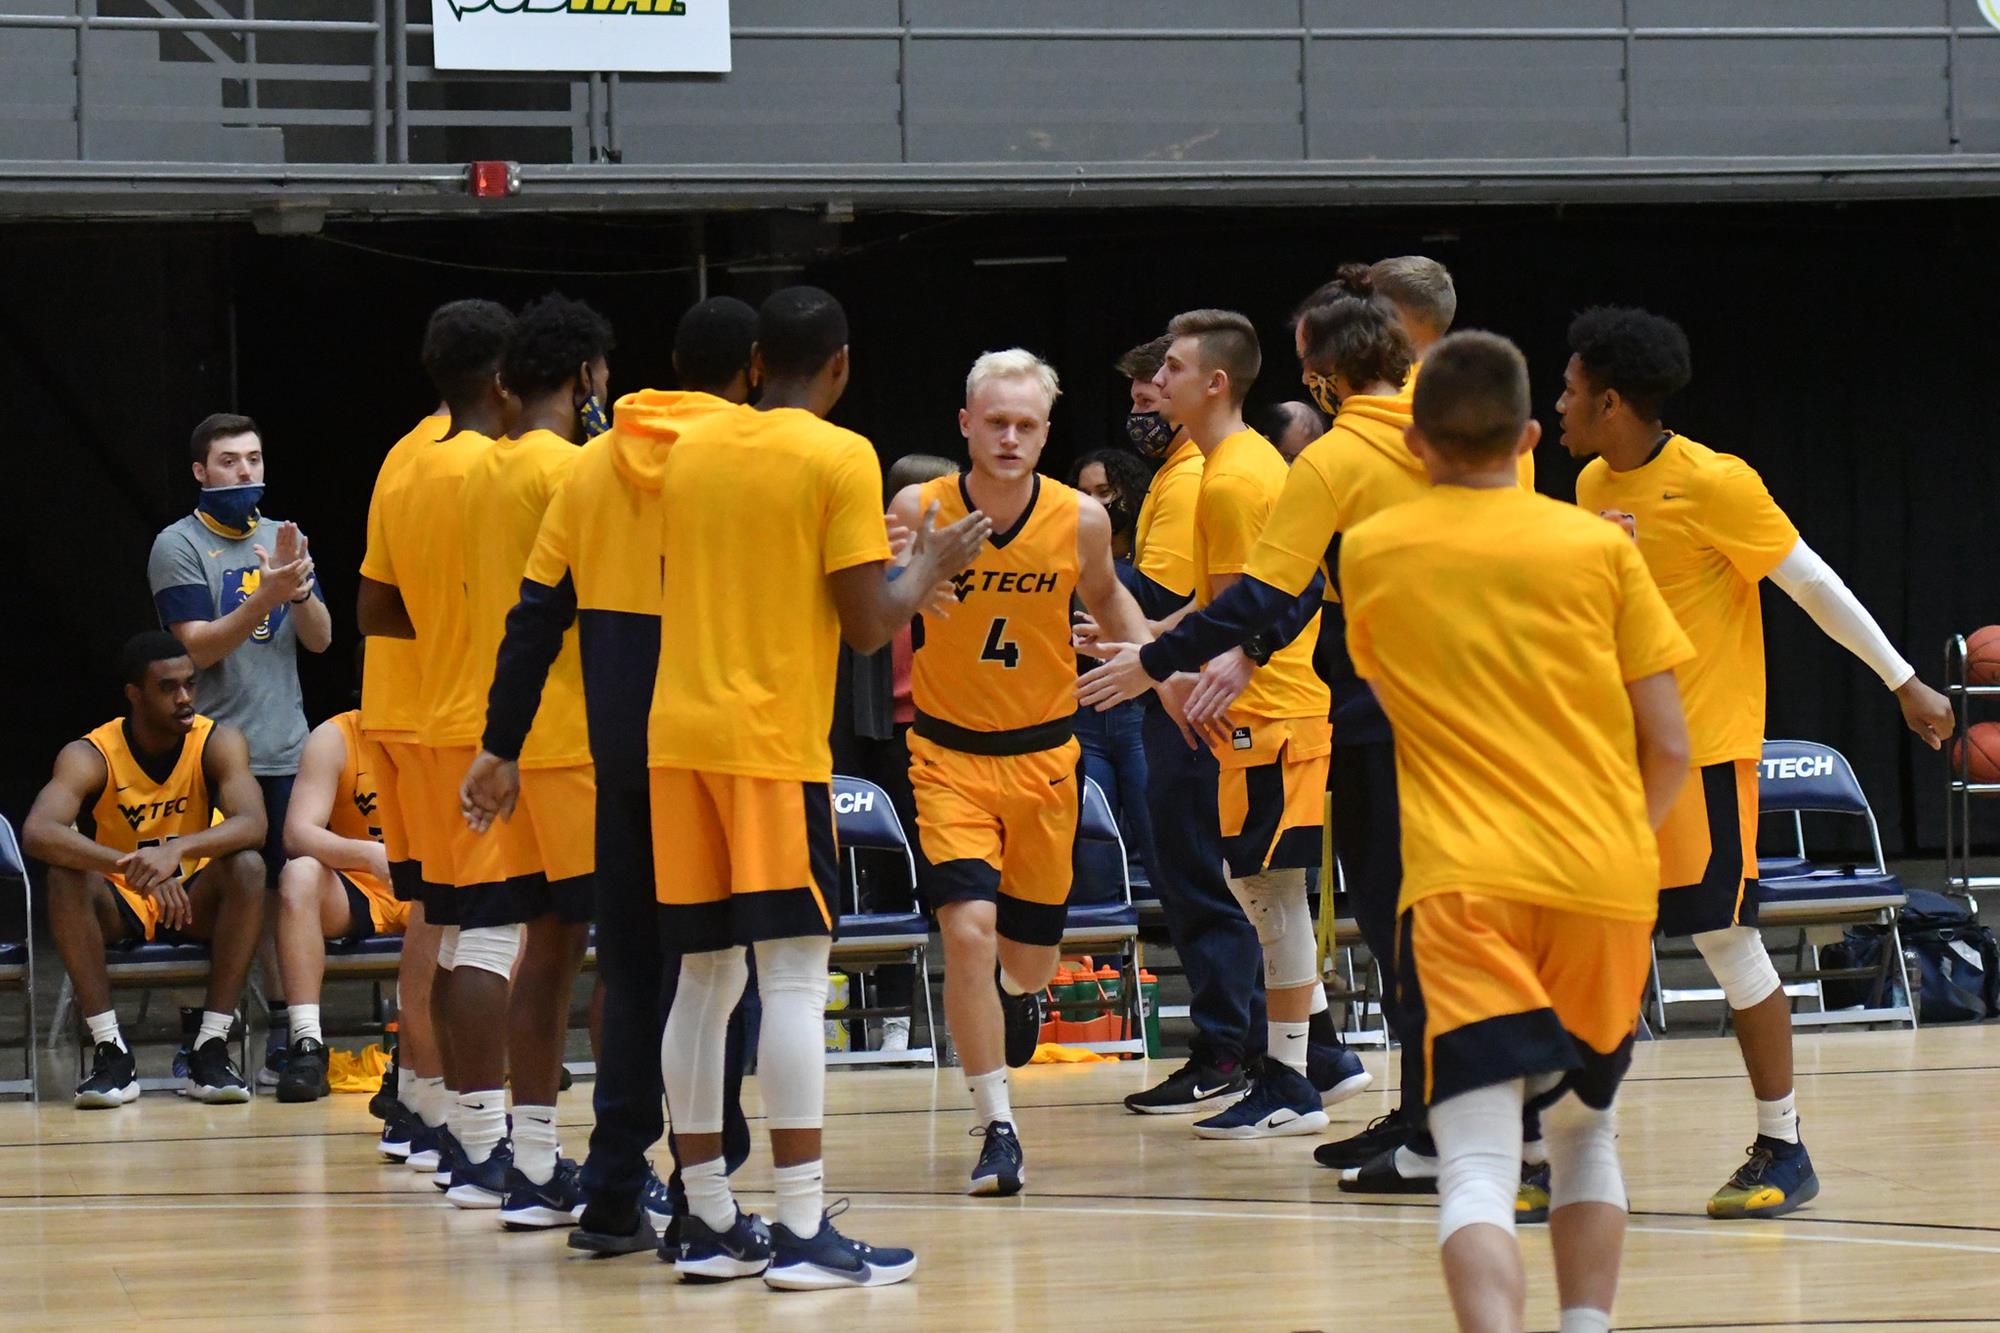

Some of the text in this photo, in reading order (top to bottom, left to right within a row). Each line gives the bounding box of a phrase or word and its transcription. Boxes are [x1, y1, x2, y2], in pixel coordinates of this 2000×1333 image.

[981, 570, 1058, 594] TECH
[979, 617, 1020, 669] 4
[1762, 755, 1834, 779] TECH
[149, 796, 189, 820] TEC
[832, 791, 875, 814] CH
